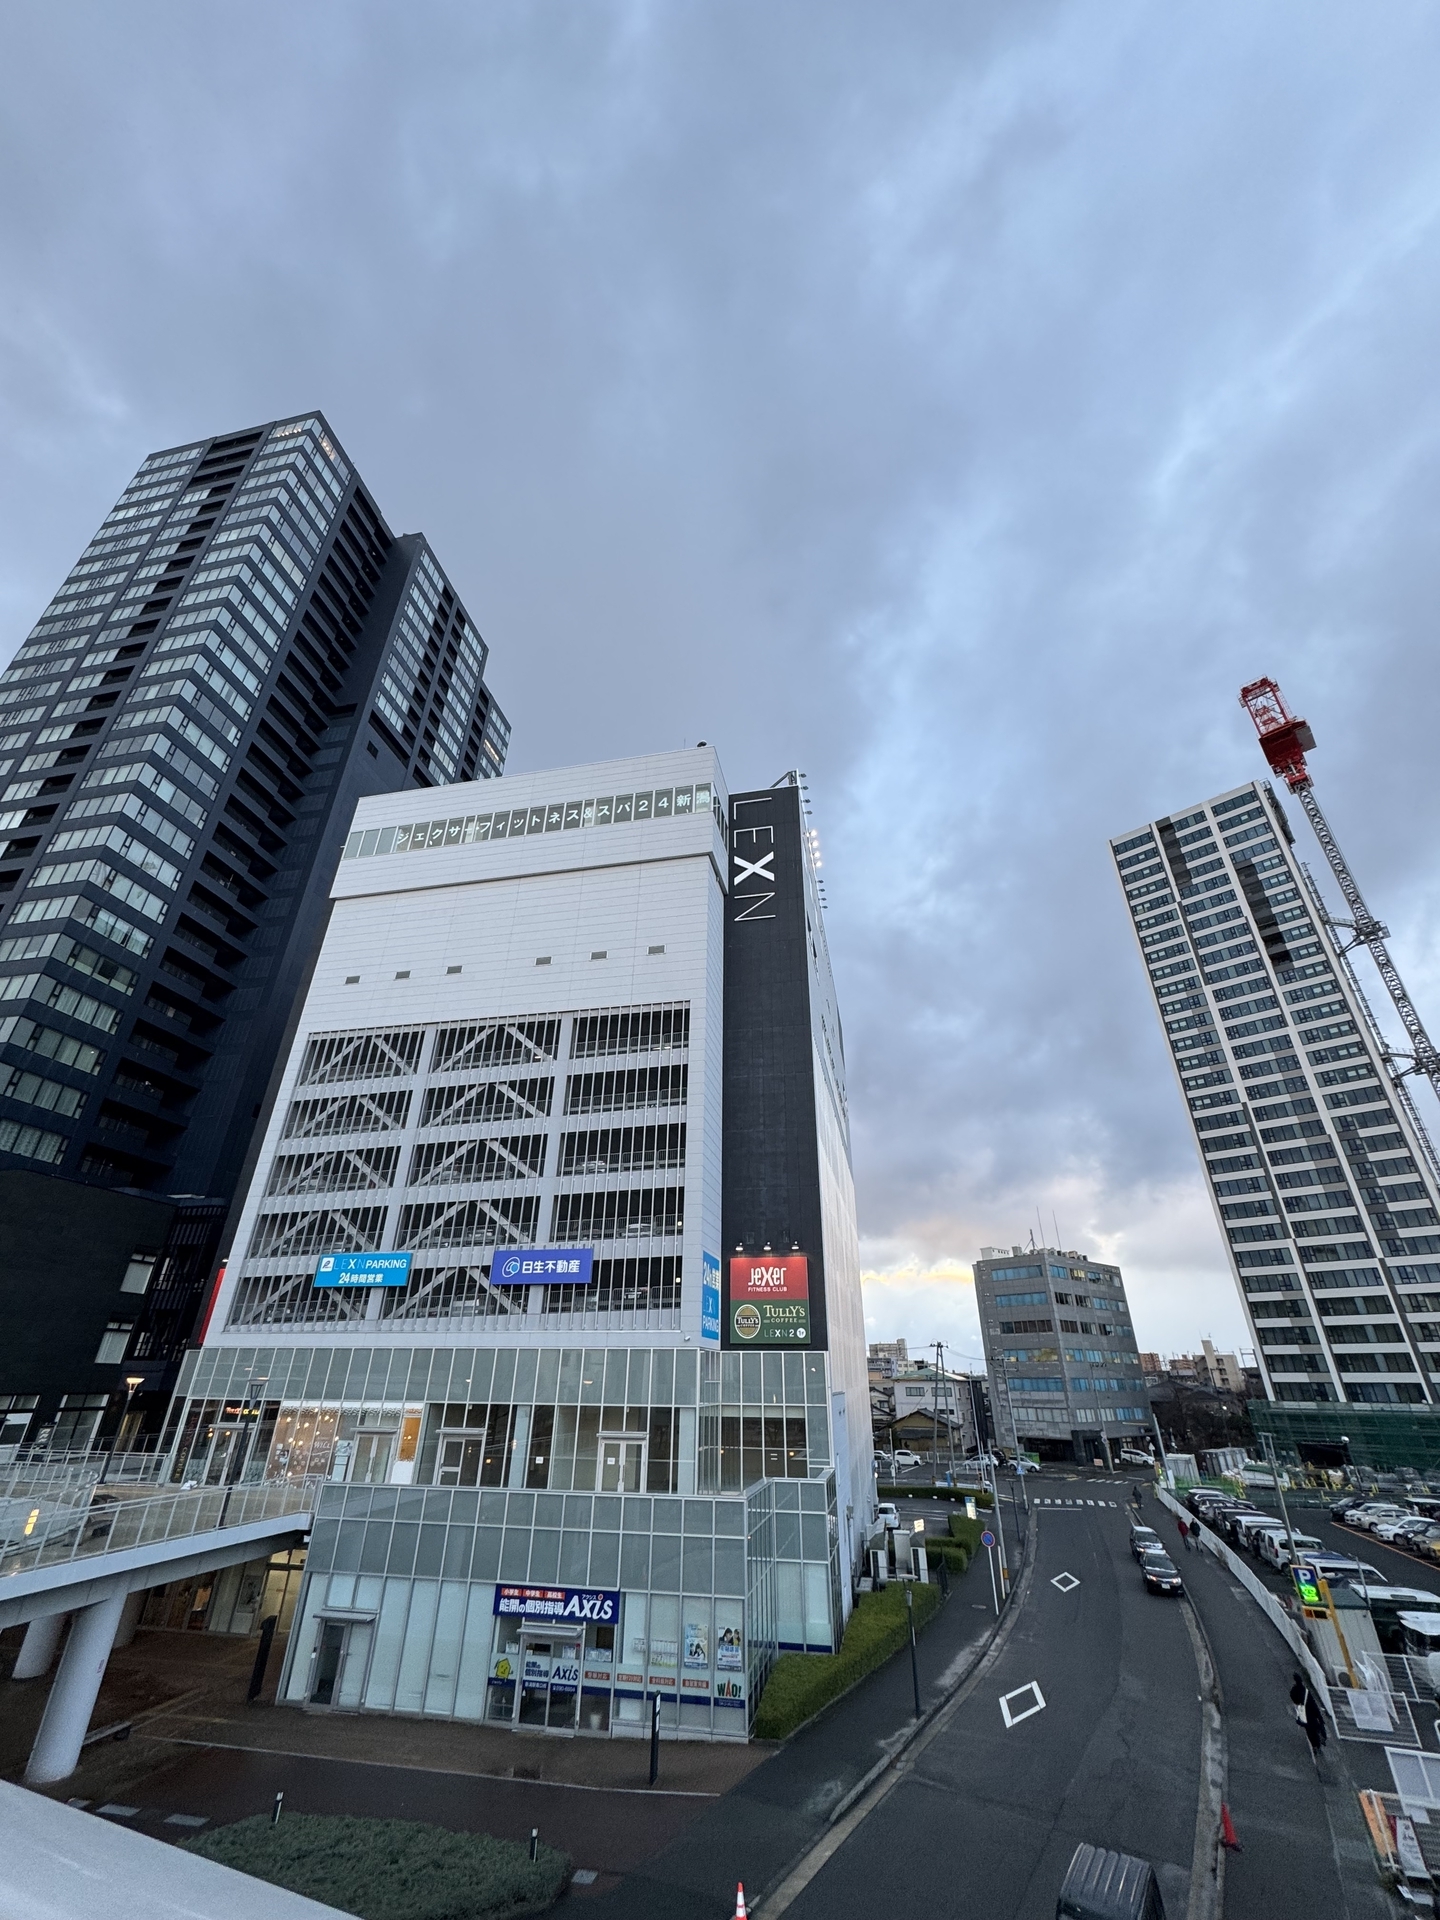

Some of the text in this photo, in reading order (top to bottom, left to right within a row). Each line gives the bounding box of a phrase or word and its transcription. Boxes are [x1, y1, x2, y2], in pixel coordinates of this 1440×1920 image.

[733, 797, 776, 921] LEXN
[365, 1259, 407, 1270] PARKING
[522, 1260, 580, 1274] 日生不動産
[338, 1272, 384, 1284] 24時間営業
[764, 1329, 788, 1338] LEXN
[1298, 1569, 1311, 1585] P
[717, 1677, 742, 1698] WAO!
